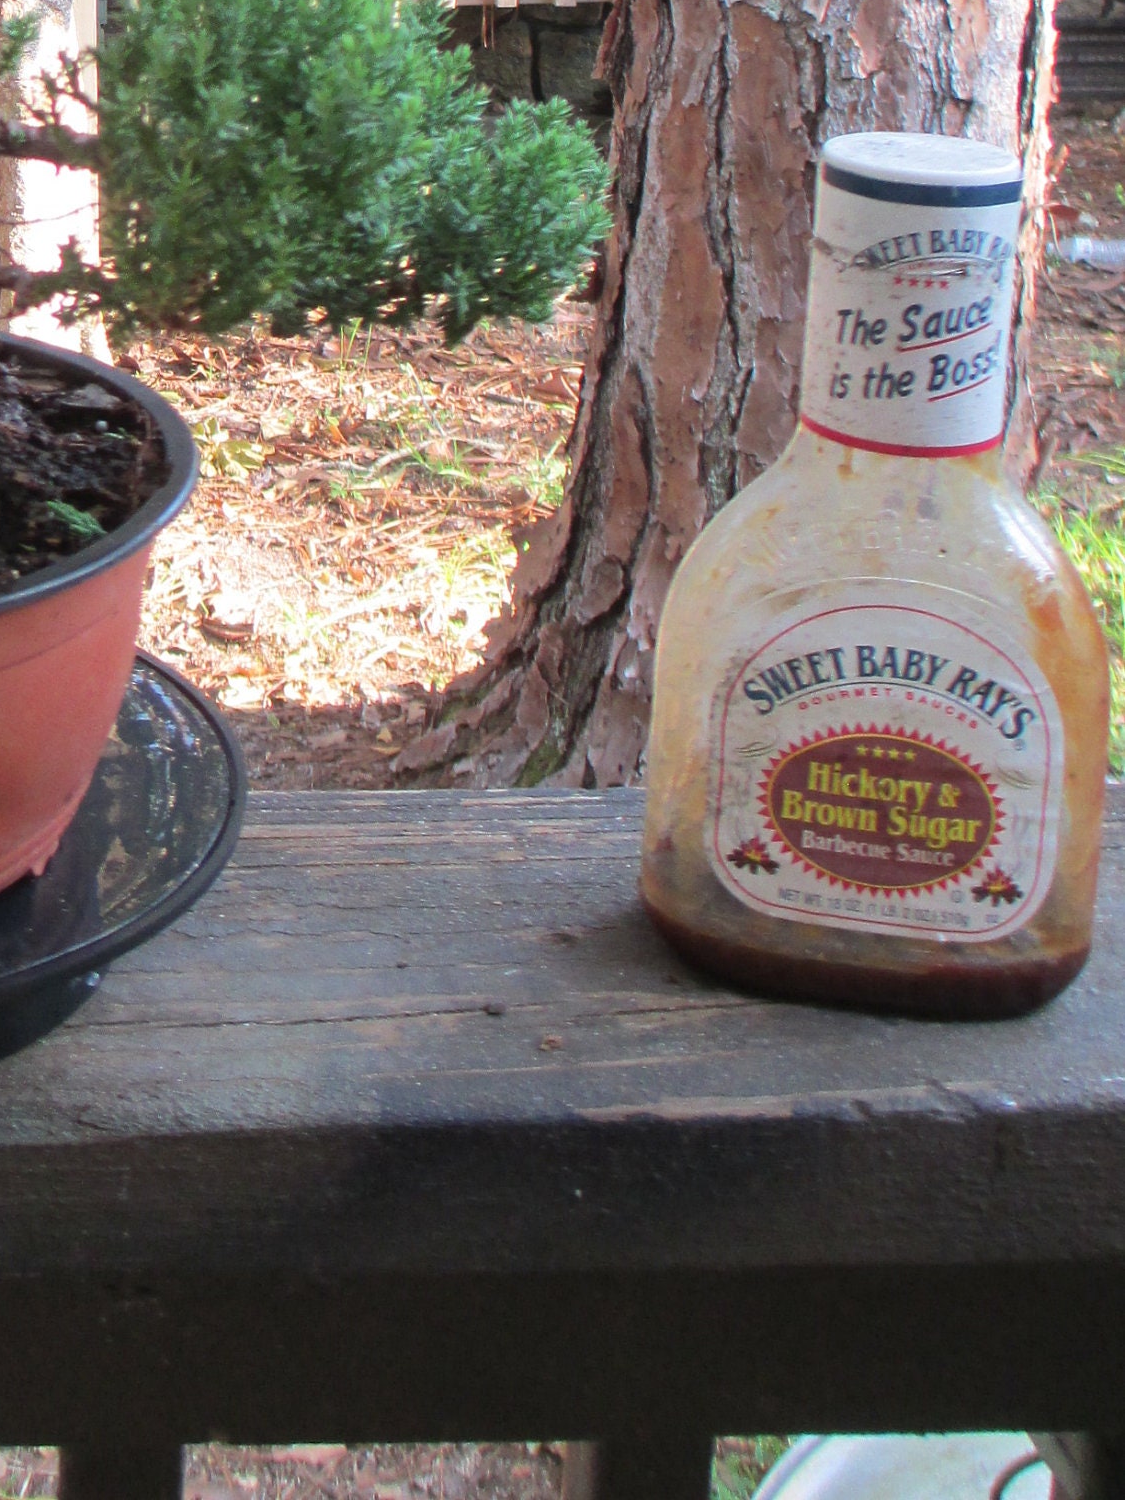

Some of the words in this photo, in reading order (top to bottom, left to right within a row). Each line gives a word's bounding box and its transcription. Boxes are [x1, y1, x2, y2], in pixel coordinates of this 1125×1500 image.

[930, 228, 989, 255] BABY
[837, 309, 888, 344] The
[898, 296, 993, 342] Sauce
[829, 362, 851, 399] is
[863, 362, 915, 398] the
[743, 646, 846, 716] SWEET
[855, 645, 953, 686] BABY
[946, 665, 1038, 740] RAY'S
[797, 686, 893, 711] GOURMET
[904, 690, 979, 729] SAUCES
[807, 761, 932, 813] Hickory
[938, 782, 962, 809] &
[779, 789, 878, 833] Brown
[887, 805, 982, 849] Sugar
[801, 829, 890, 861] Barbecue
[895, 842, 956, 867] Sauce
